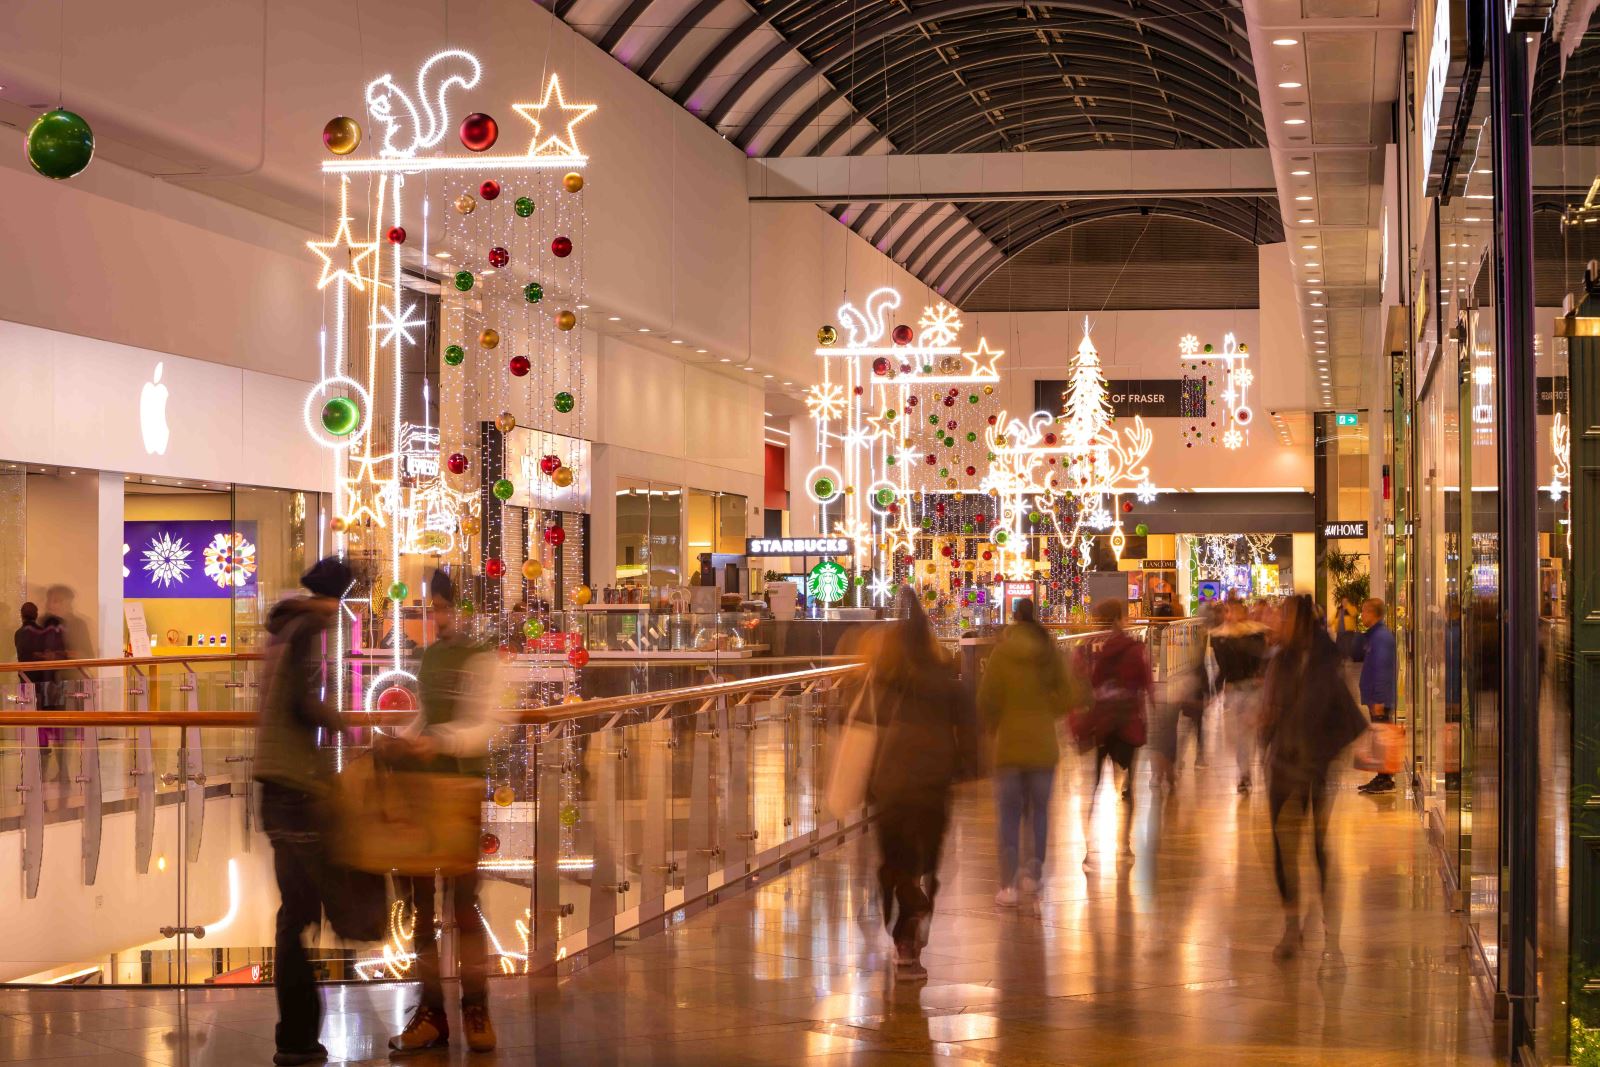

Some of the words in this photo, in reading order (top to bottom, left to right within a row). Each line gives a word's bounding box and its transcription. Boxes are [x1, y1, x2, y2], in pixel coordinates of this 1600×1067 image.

[1112, 394, 1126, 403] OF
[1128, 394, 1165, 403] FRASER
[1336, 524, 1364, 536] HOME
[751, 539, 848, 553] STARBUCKS
